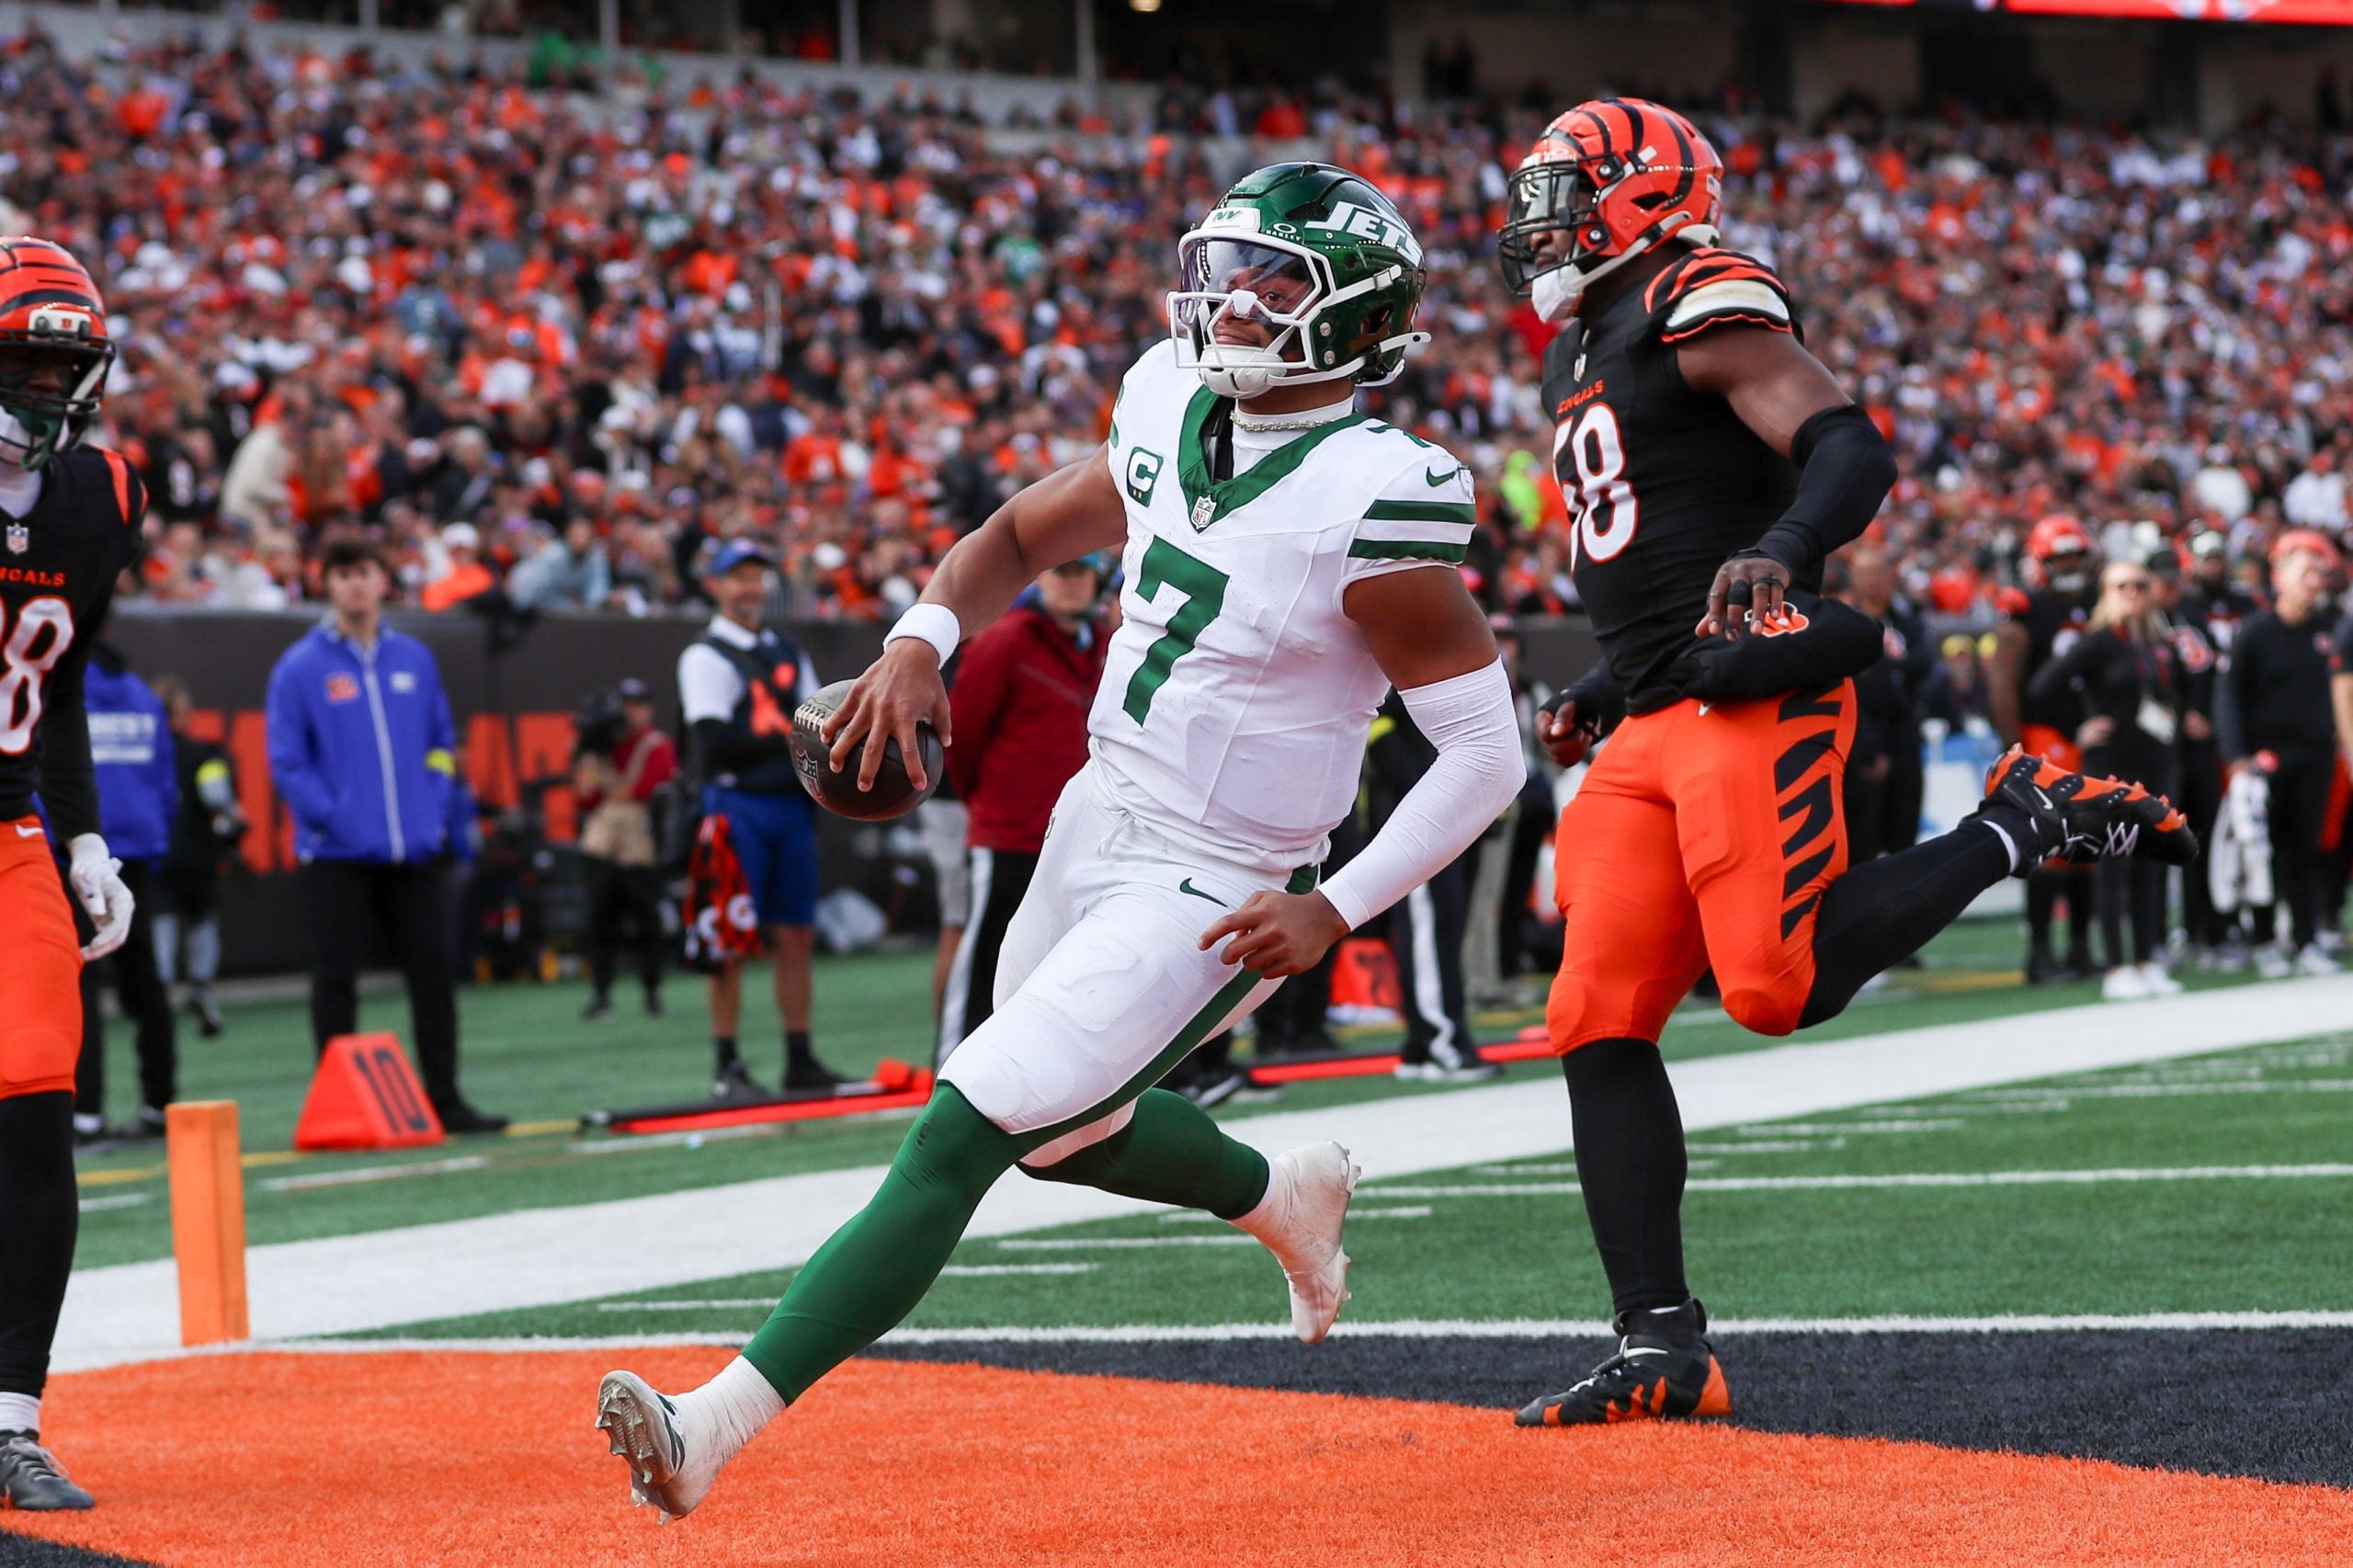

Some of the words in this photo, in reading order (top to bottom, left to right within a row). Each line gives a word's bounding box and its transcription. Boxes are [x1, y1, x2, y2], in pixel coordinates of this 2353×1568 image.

[1266, 229, 1302, 241] OAKLEY
[1305, 200, 1423, 267] JETS
[1128, 450, 1159, 493] C
[1122, 534, 1231, 728] 7
[0, 594, 74, 756] 8
[354, 1049, 428, 1134] 10
